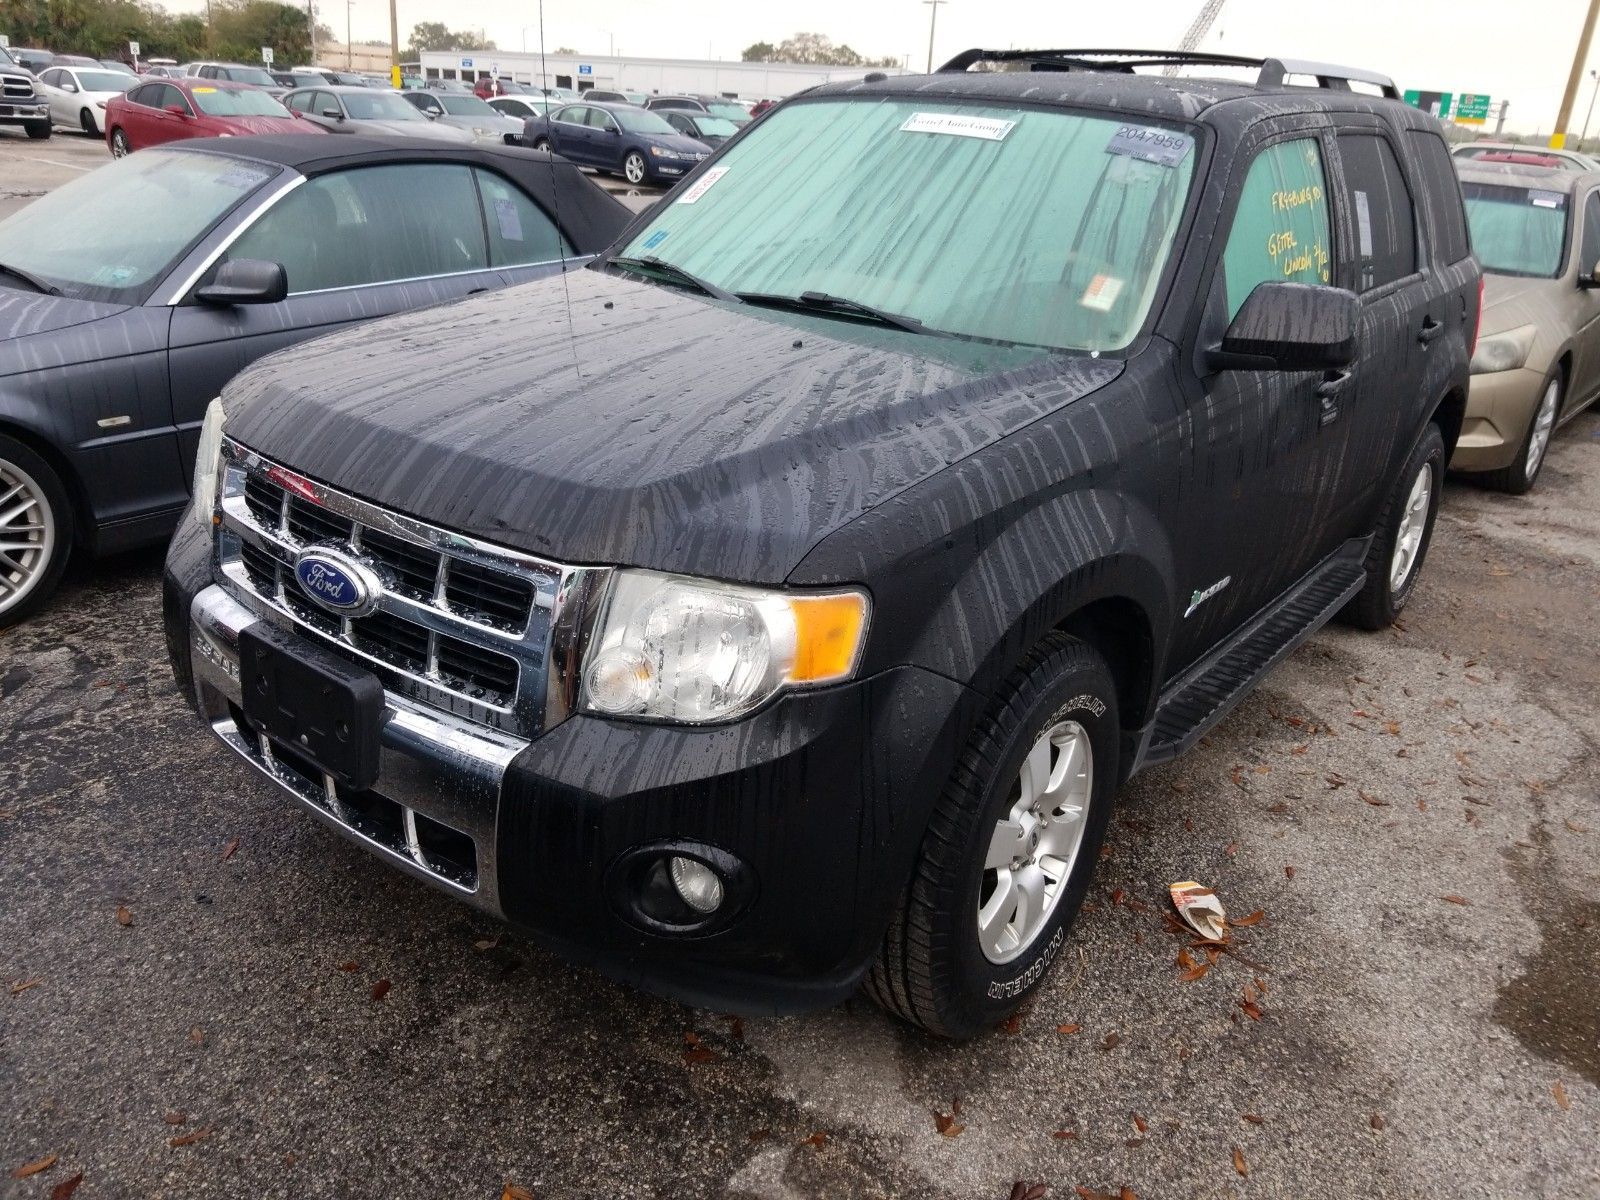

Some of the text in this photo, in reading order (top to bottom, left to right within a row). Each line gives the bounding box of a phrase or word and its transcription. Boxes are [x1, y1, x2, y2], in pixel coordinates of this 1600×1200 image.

[1116, 126, 1185, 151] 2047959
[307, 563, 345, 598] Ford
[987, 926, 1064, 1000] MICHELIN
